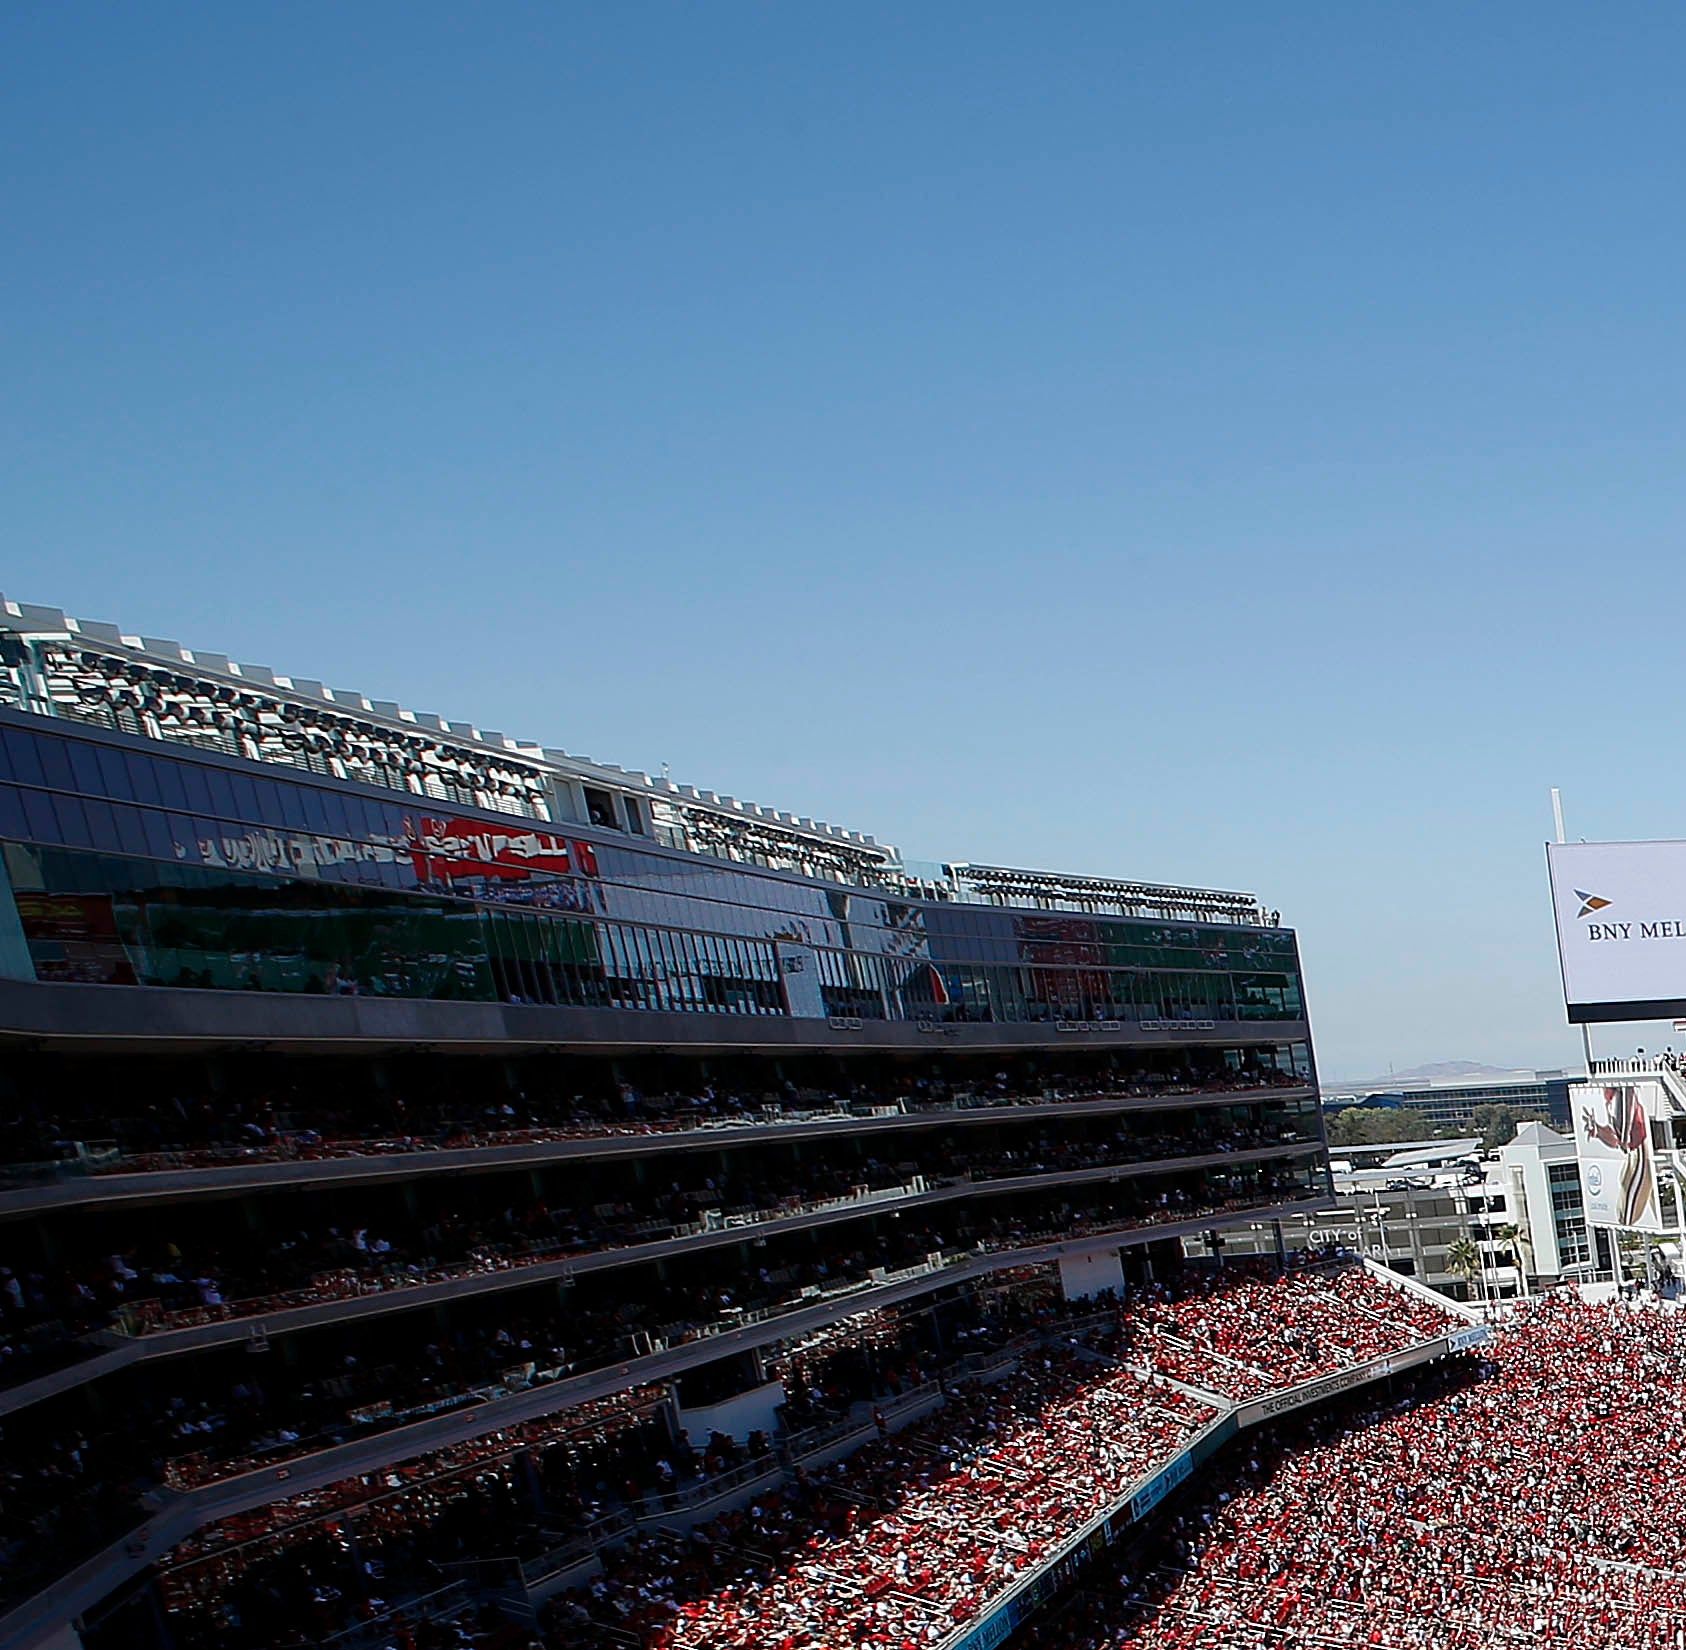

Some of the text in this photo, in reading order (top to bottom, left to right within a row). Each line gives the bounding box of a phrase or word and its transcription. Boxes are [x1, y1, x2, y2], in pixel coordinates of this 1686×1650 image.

[1588, 923, 1632, 940] BNY
[1309, 1226, 1362, 1244] CITY of
